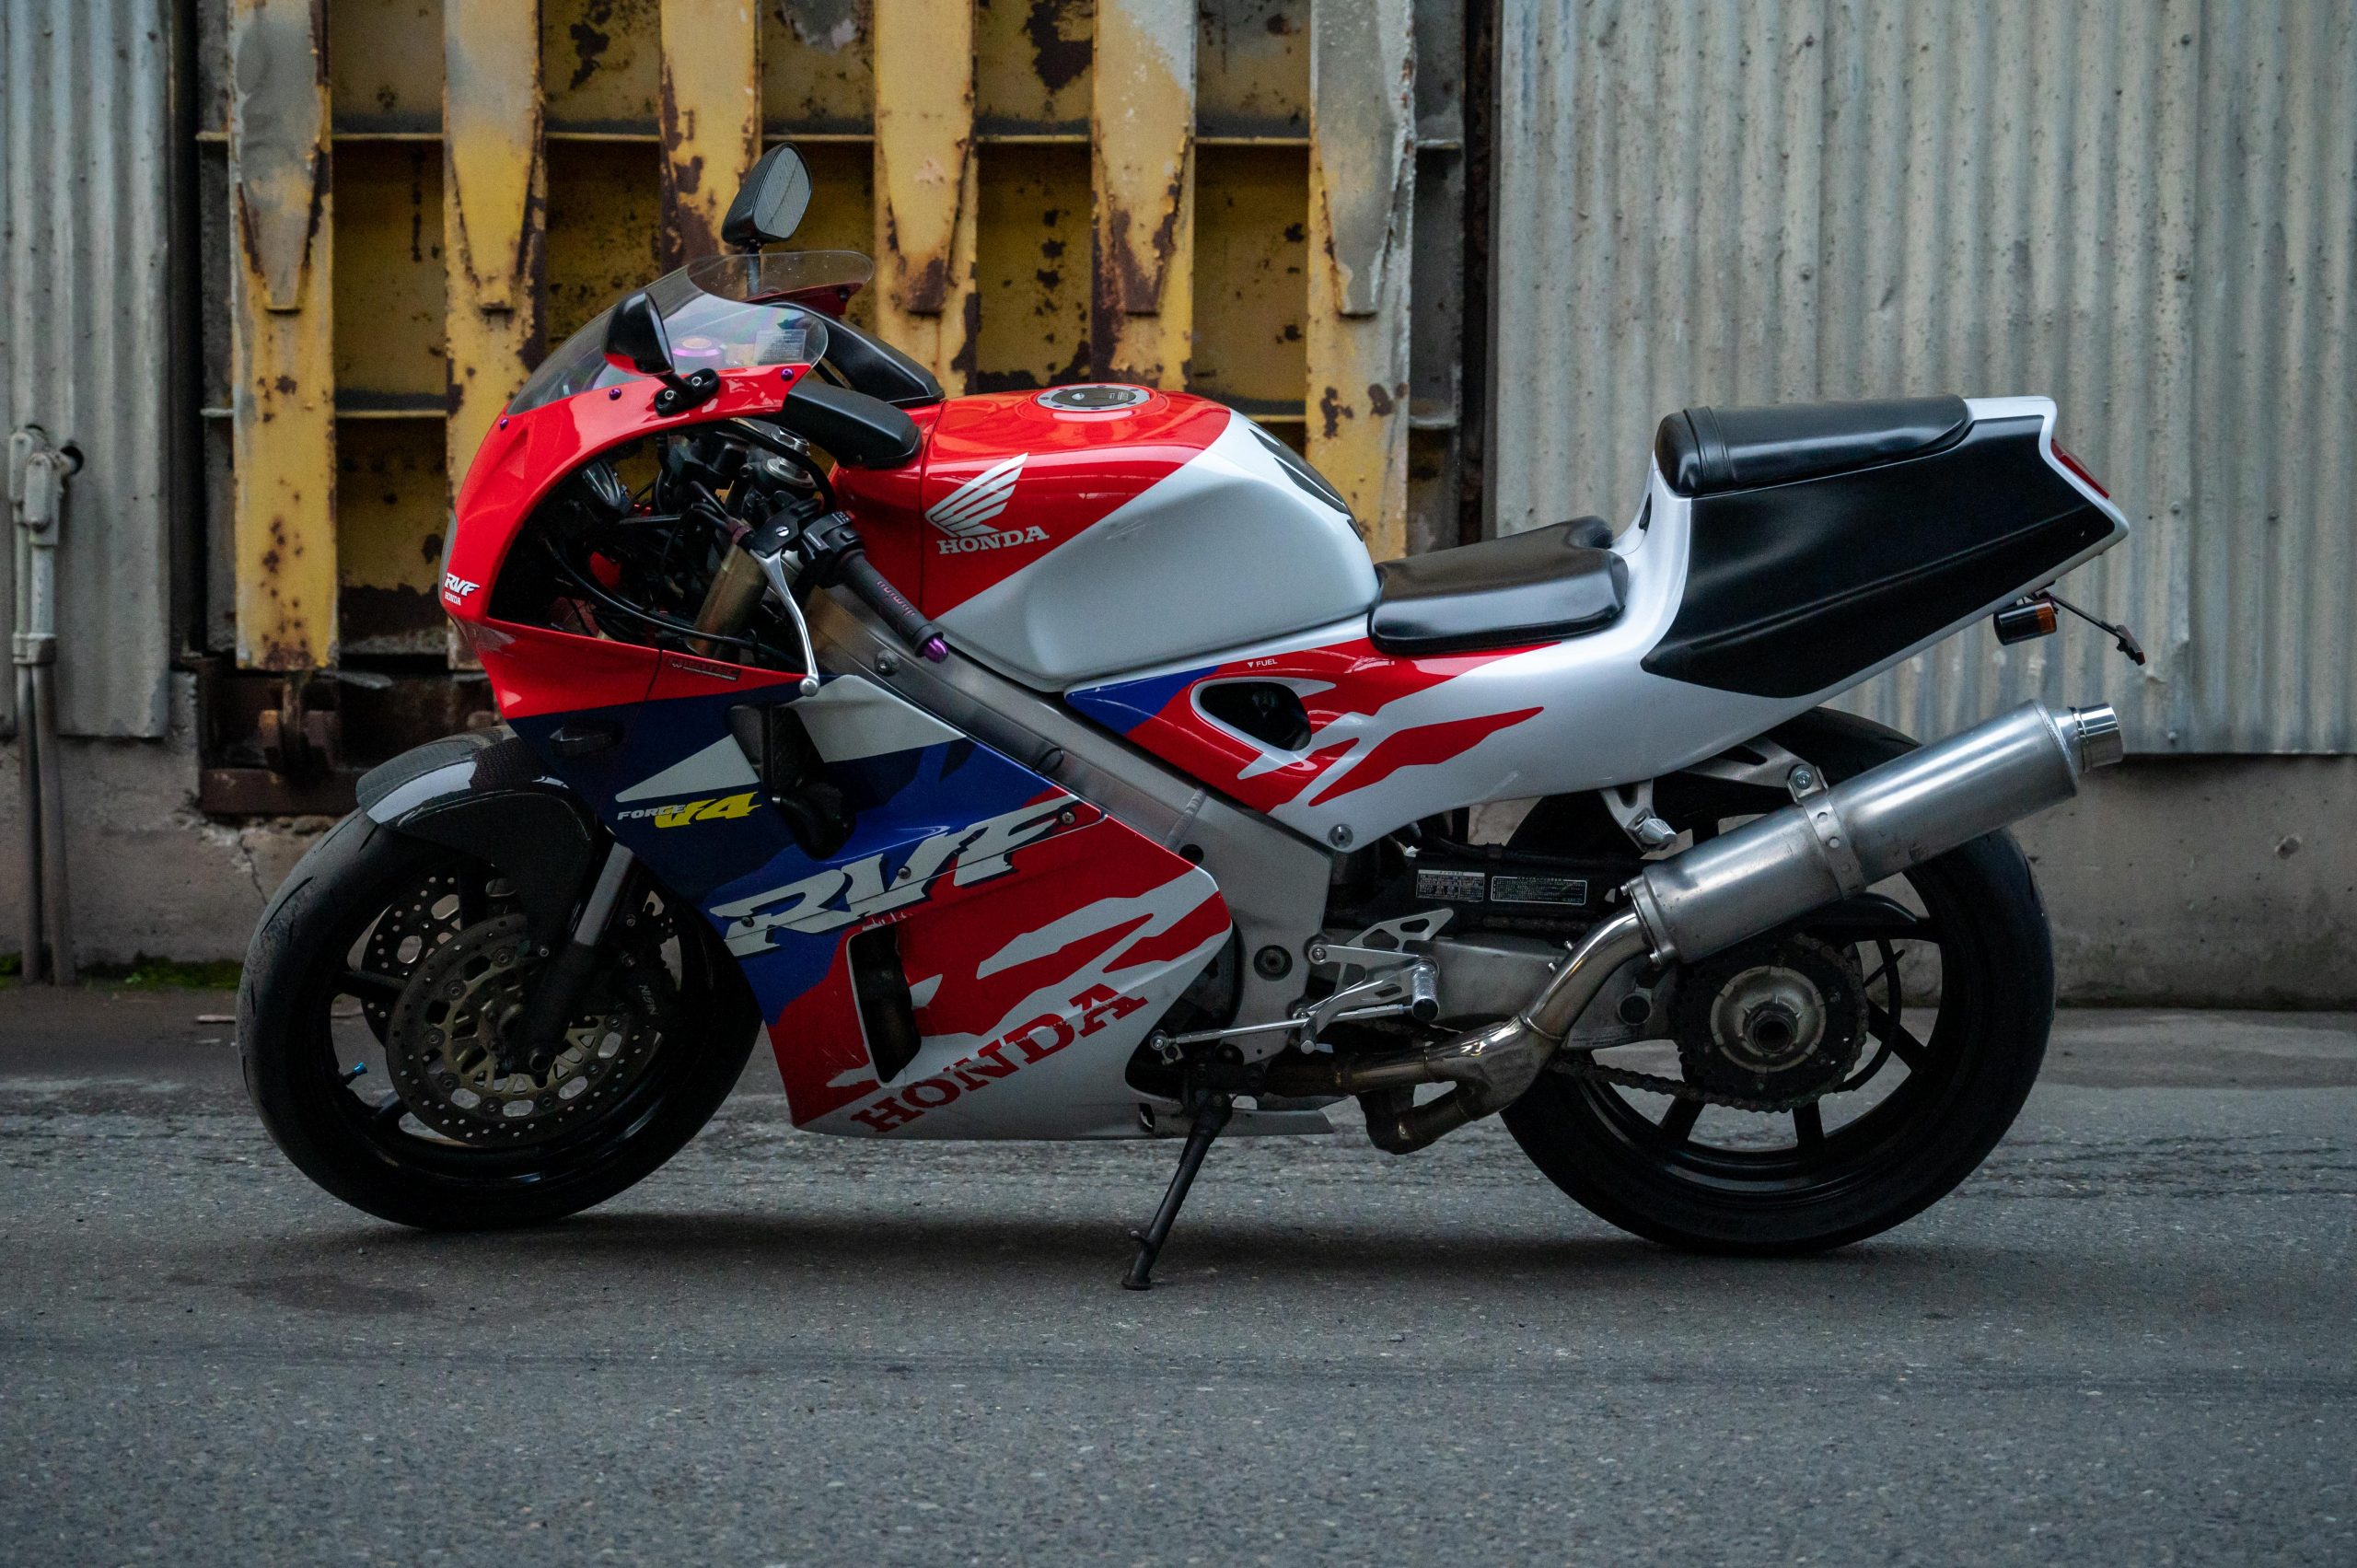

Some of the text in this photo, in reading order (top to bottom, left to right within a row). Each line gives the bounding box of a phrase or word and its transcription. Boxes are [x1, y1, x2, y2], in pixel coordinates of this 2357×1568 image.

[936, 526, 1050, 554] HONDA
[444, 591, 461, 606] HONDA
[445, 572, 481, 597] RVF
[1256, 658, 1278, 668] FUEL
[617, 791, 762, 829] FORCE V4
[709, 794, 1079, 957] RVF
[850, 983, 1149, 1132] HONDA
